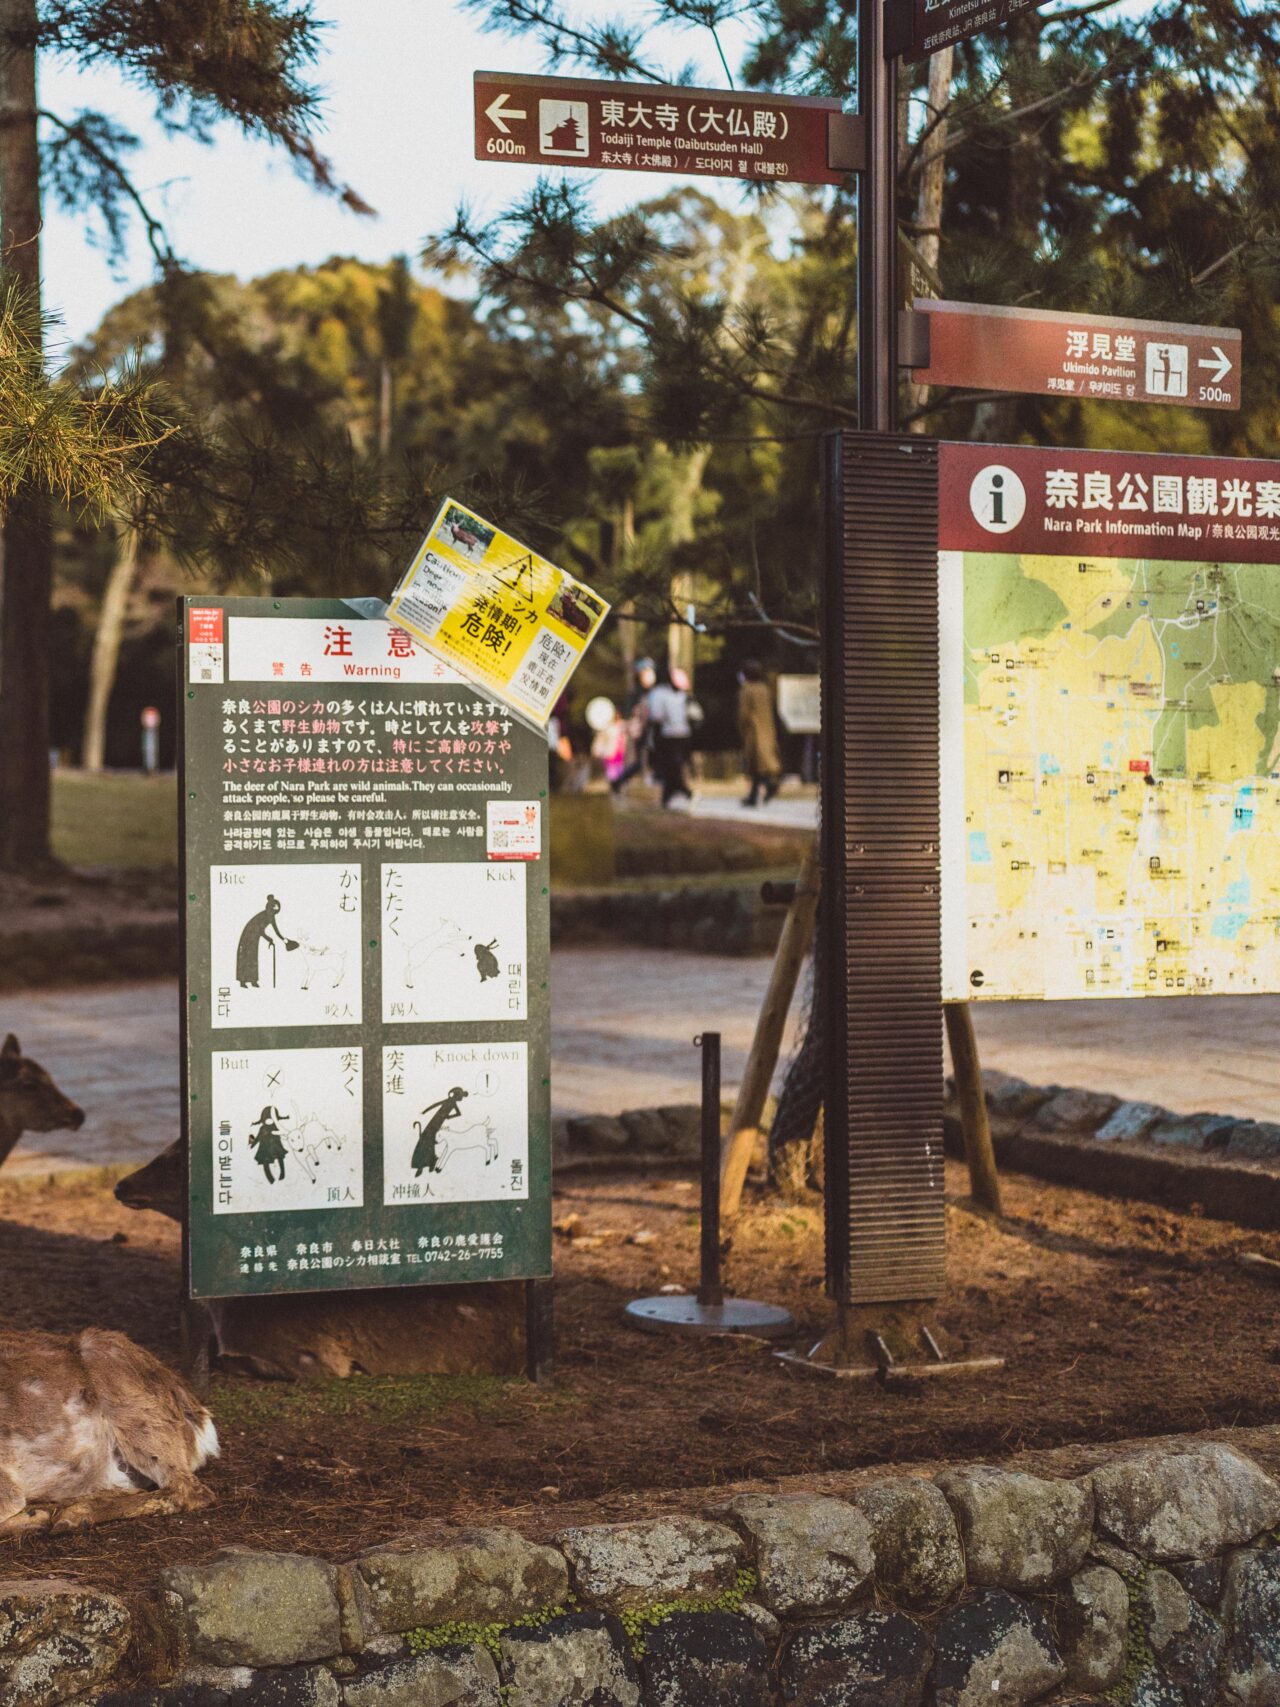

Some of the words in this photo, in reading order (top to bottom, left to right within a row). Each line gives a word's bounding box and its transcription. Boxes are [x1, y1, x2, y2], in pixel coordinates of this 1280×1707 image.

[487, 138, 526, 155] 600m
[601, 132, 634, 147] Todaiji
[637, 134, 671, 148] Temple
[674, 137, 738, 153] (Daibutsuden
[740, 143, 763, 154] Hall)
[1066, 330, 1136, 362] 浮見堂
[1063, 362, 1100, 375] Ukimido
[1102, 366, 1136, 378] Pavilion
[1199, 387, 1231, 403] 500m
[1044, 518, 1072, 532] Nara
[1076, 519, 1102, 533] Park
[1106, 520, 1175, 536] Information
[1178, 523, 1202, 538] Map
[460, 612, 512, 657] 危険！
[343, 664, 401, 678] Warning
[223, 757, 504, 774] 小さなお子様連れの方は注意してください。
[223, 781, 242, 791] The
[244, 781, 266, 791] deer
[267, 781, 278, 791] of
[281, 781, 305, 791] Nara
[308, 781, 330, 791] Park
[332, 783, 348, 791] are
[350, 781, 370, 791] wild
[437, 783, 454, 791] can
[456, 781, 512, 793] occasionally
[223, 793, 253, 803] attack
[293, 795, 304, 803] so
[306, 793, 336, 805] please
[338, 792, 350, 802] be
[351, 792, 387, 803] careful.
[277, 828, 296, 838] 있는
[219, 872, 246, 884] Bite
[486, 868, 516, 881] Kick
[340, 870, 358, 912] かむ
[386, 868, 403, 936] たたく
[221, 1056, 249, 1070] Butt
[434, 1050, 478, 1063] Knock
[483, 1048, 519, 1062] down
[340, 1051, 359, 1097] 突く
[386, 1050, 404, 1095] 突進
[510, 1159, 523, 1191] 돌진
[240, 1244, 278, 1259] 奈良県
[296, 1241, 333, 1255] 奈良市
[351, 1237, 400, 1252] 春日大社
[418, 1232, 504, 1249] 奈良の鹿愛護会
[287, 1253, 401, 1271] 奈良公園のシカ相談室
[407, 1253, 422, 1264] TEL
[425, 1248, 504, 1263] 0742-26-7755
